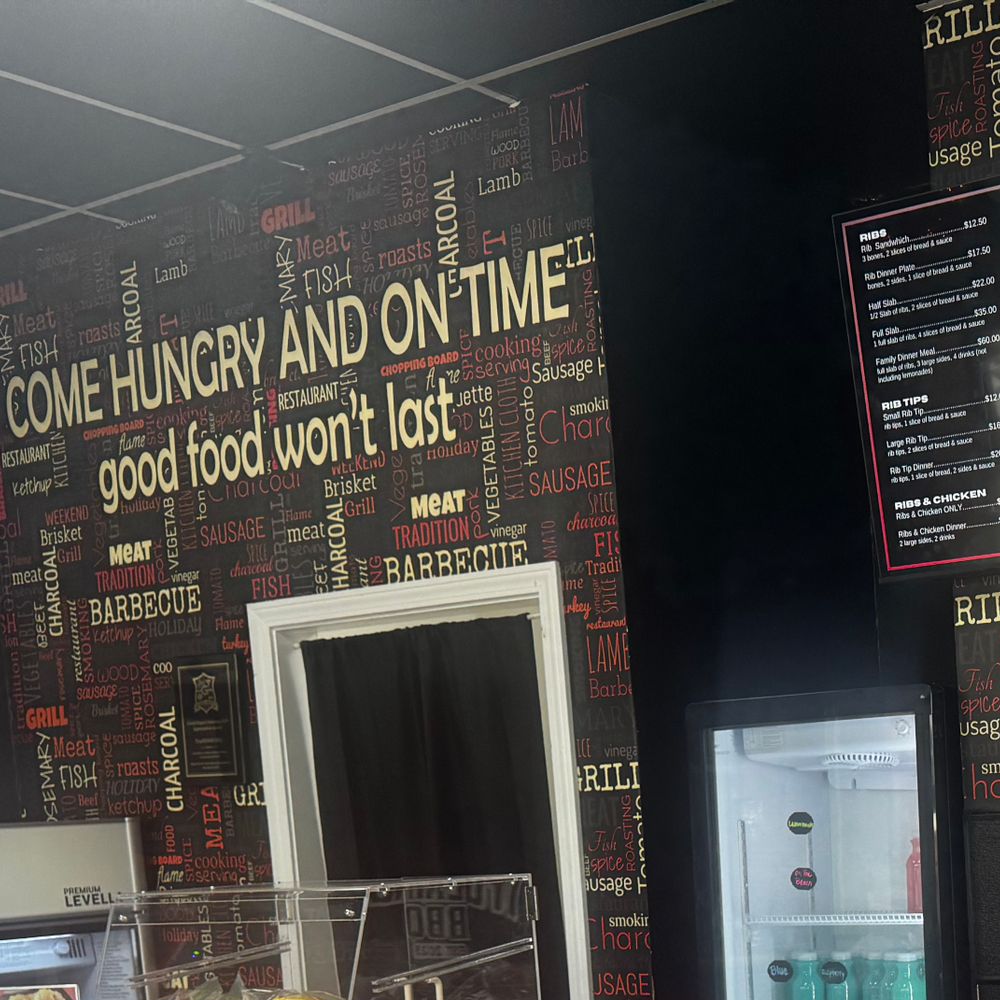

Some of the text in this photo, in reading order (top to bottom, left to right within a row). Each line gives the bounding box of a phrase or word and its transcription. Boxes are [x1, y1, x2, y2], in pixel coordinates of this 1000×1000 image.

[477, 167, 521, 196] Lamb
[261, 199, 316, 234] GRILL
[296, 227, 351, 263] Meat
[860, 228, 887, 242] RIBS
[861, 243, 872, 253] Rib
[963, 216, 987, 229] $12.50
[379, 241, 431, 269] roasts
[865, 271, 875, 280] Rib
[876, 266, 897, 278] Dinner
[967, 245, 991, 257] $17.50
[302, 257, 353, 299] FISH
[6, 242, 570, 438] COME HUNGRY AND ON TIME
[475, 334, 541, 362] cooking
[380, 350, 459, 377] CHOPPING BOARD
[532, 356, 594, 386] Sausage
[882, 394, 928, 410] RIB TIPS
[1, 443, 50, 468] RESTAURANT
[99, 377, 458, 515] good food won't last
[480, 405, 501, 524] VEGETABLES
[529, 460, 613, 497] SAUSAGE
[895, 499, 921, 510] RIBS
[932, 488, 986, 504] CHICKEN
[897, 512, 910, 520] Ribs
[916, 507, 942, 517] Chicken
[40, 525, 83, 547] Brisket
[392, 516, 470, 550] TRADITION
[490, 523, 527, 539] vinegar
[42, 546, 63, 637] CHARCOAL
[88, 585, 202, 627] BARBECUE
[26, 705, 68, 729] GRILL
[53, 734, 95, 758] Meat
[159, 706, 184, 812] CHARCOAL
[59, 761, 97, 790] FISH
[63, 886, 100, 895] PREMIUM
